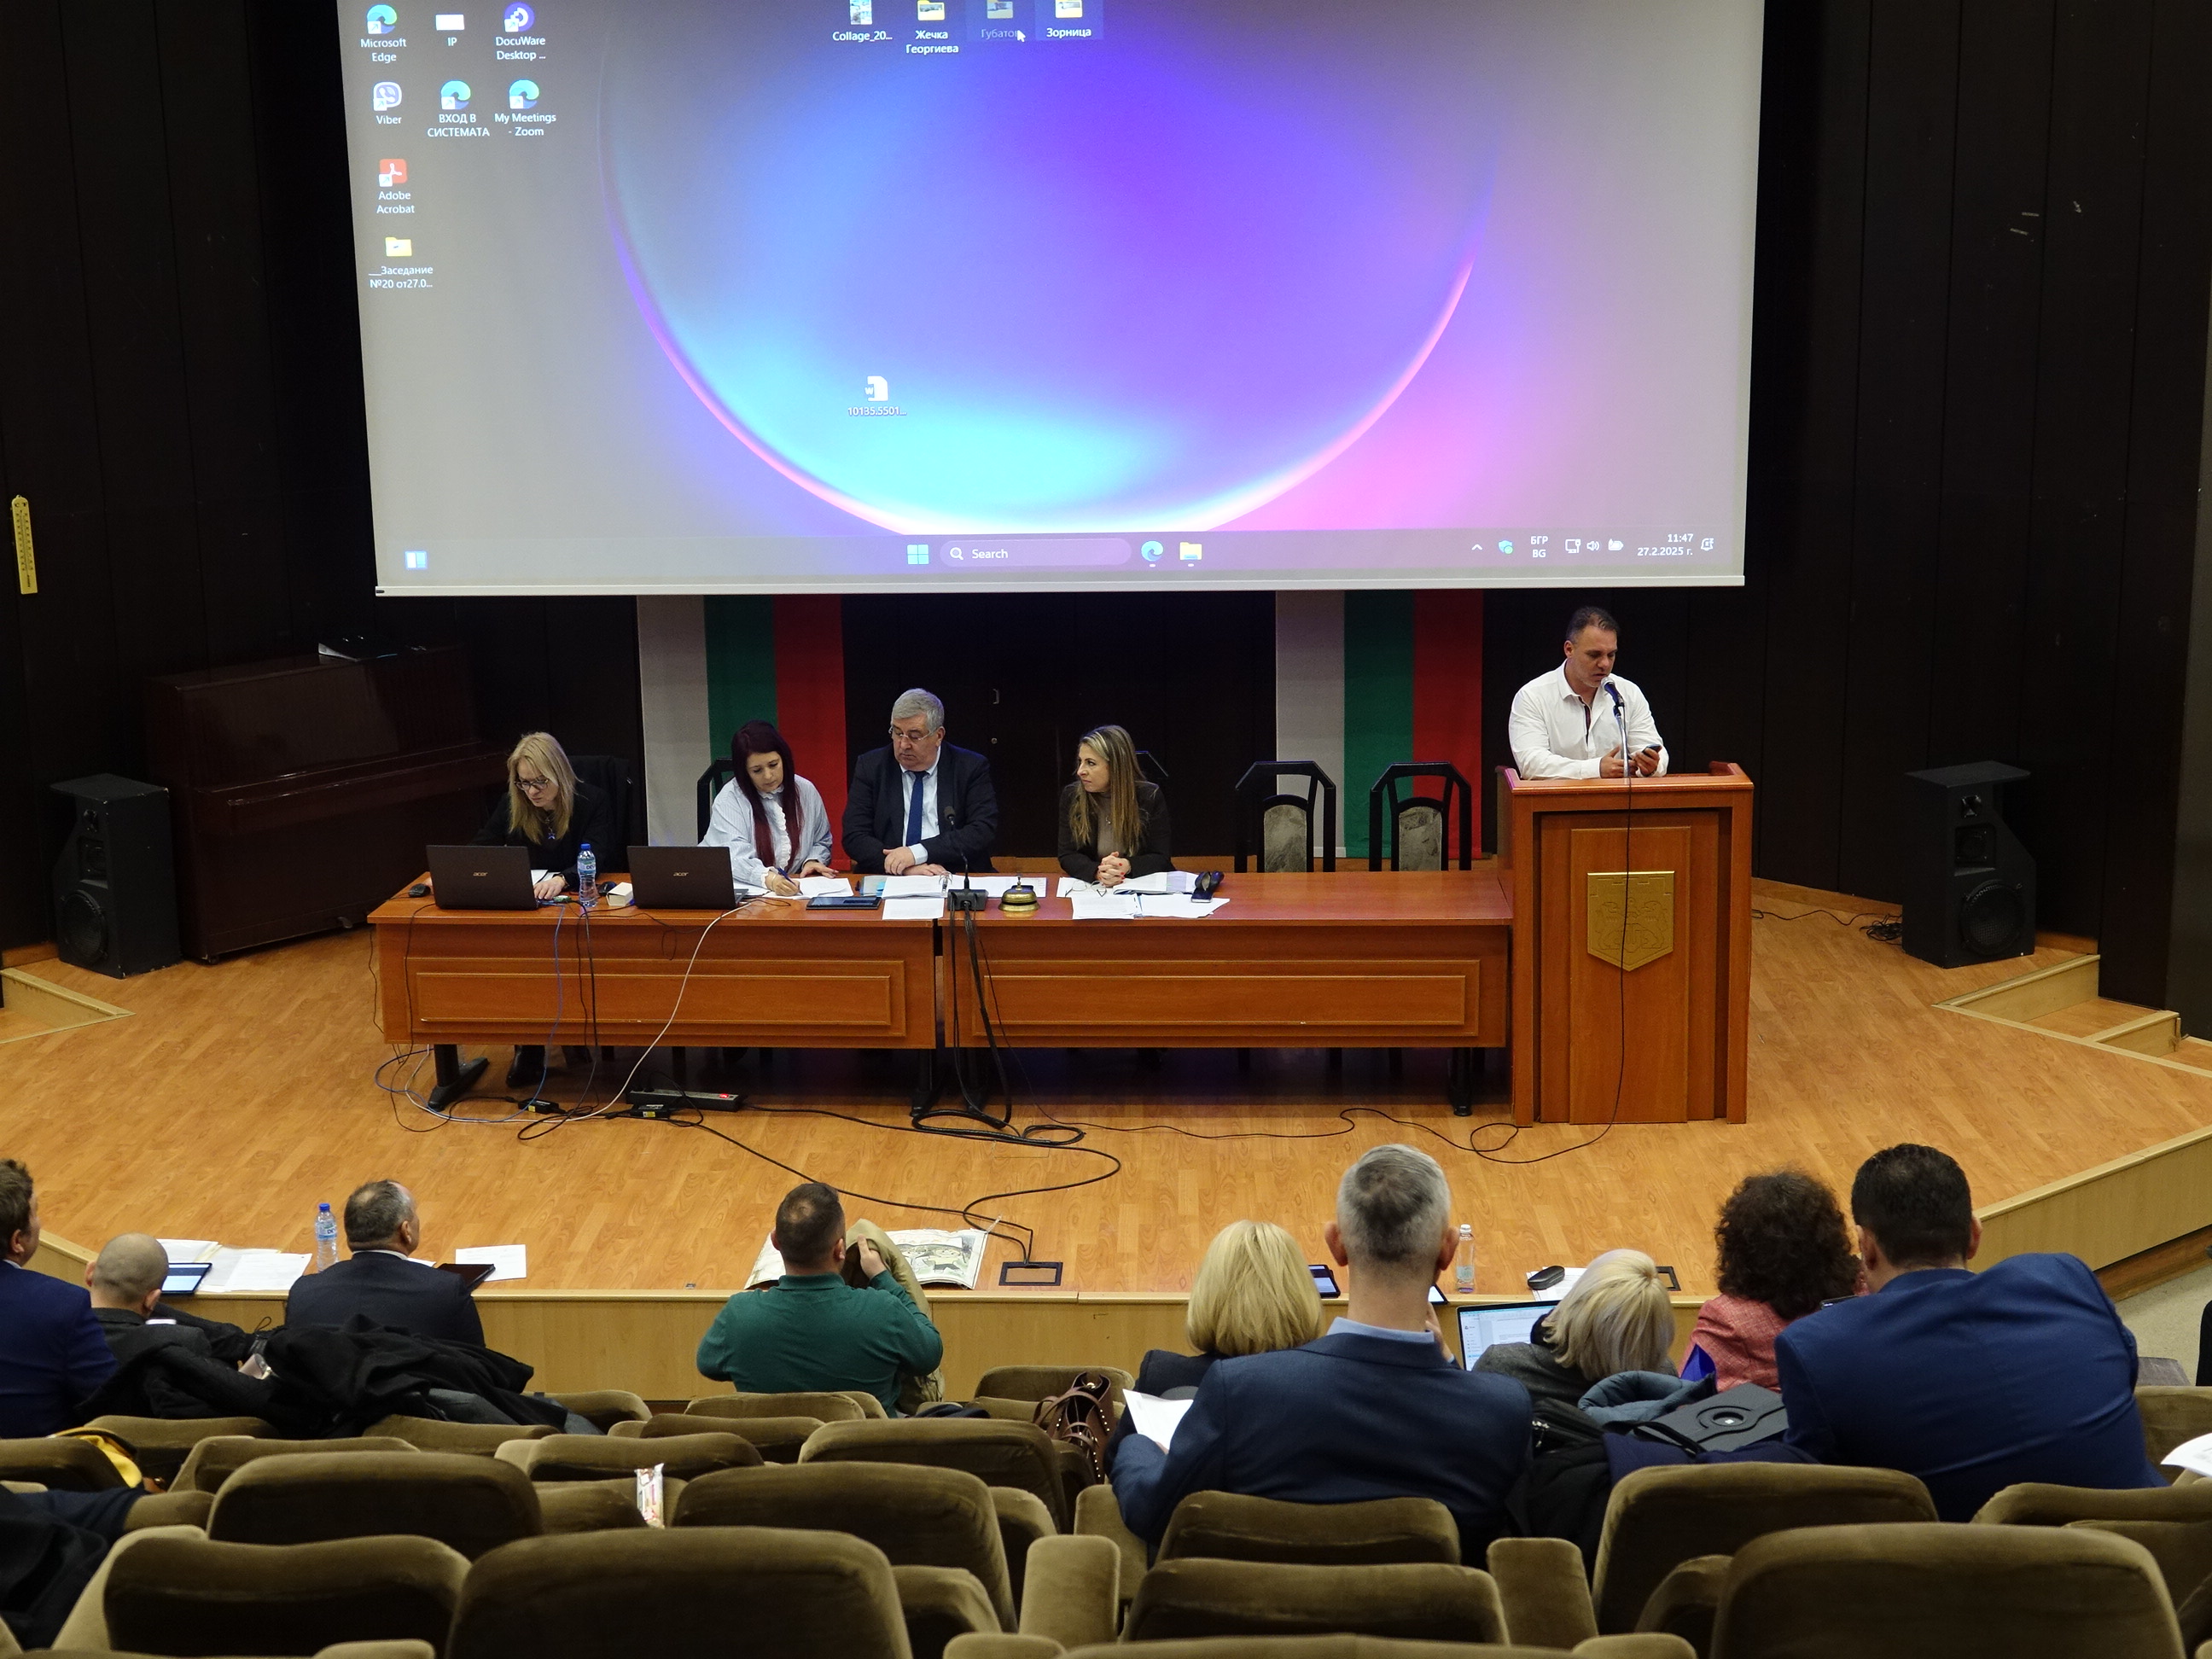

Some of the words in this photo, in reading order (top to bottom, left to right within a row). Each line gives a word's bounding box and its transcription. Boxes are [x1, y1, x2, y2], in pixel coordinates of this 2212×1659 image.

[915, 30, 948, 40] Жечка
[1046, 27, 1091, 38] Зорница
[360, 38, 406, 48] Microsoft
[447, 37, 457, 46] IP
[495, 37, 546, 46] DocuWare
[905, 44, 959, 55] Георгиева
[371, 52, 397, 64] Edge
[496, 50, 537, 61] Desktop
[375, 114, 402, 125] Viber
[439, 114, 468, 125] ВХОД
[494, 114, 510, 125] My
[512, 113, 556, 125] Meetings
[427, 127, 490, 137] СИСТЕМАТА
[515, 126, 544, 137] Zoom
[378, 191, 410, 200] Adobe
[376, 204, 415, 214] Acrobat
[1530, 535, 1549, 545] БГР
[1667, 533, 1694, 543] 11:47
[972, 549, 1008, 559] Search
[1532, 549, 1546, 558] BG
[1637, 547, 1684, 556] 27.2.2025
